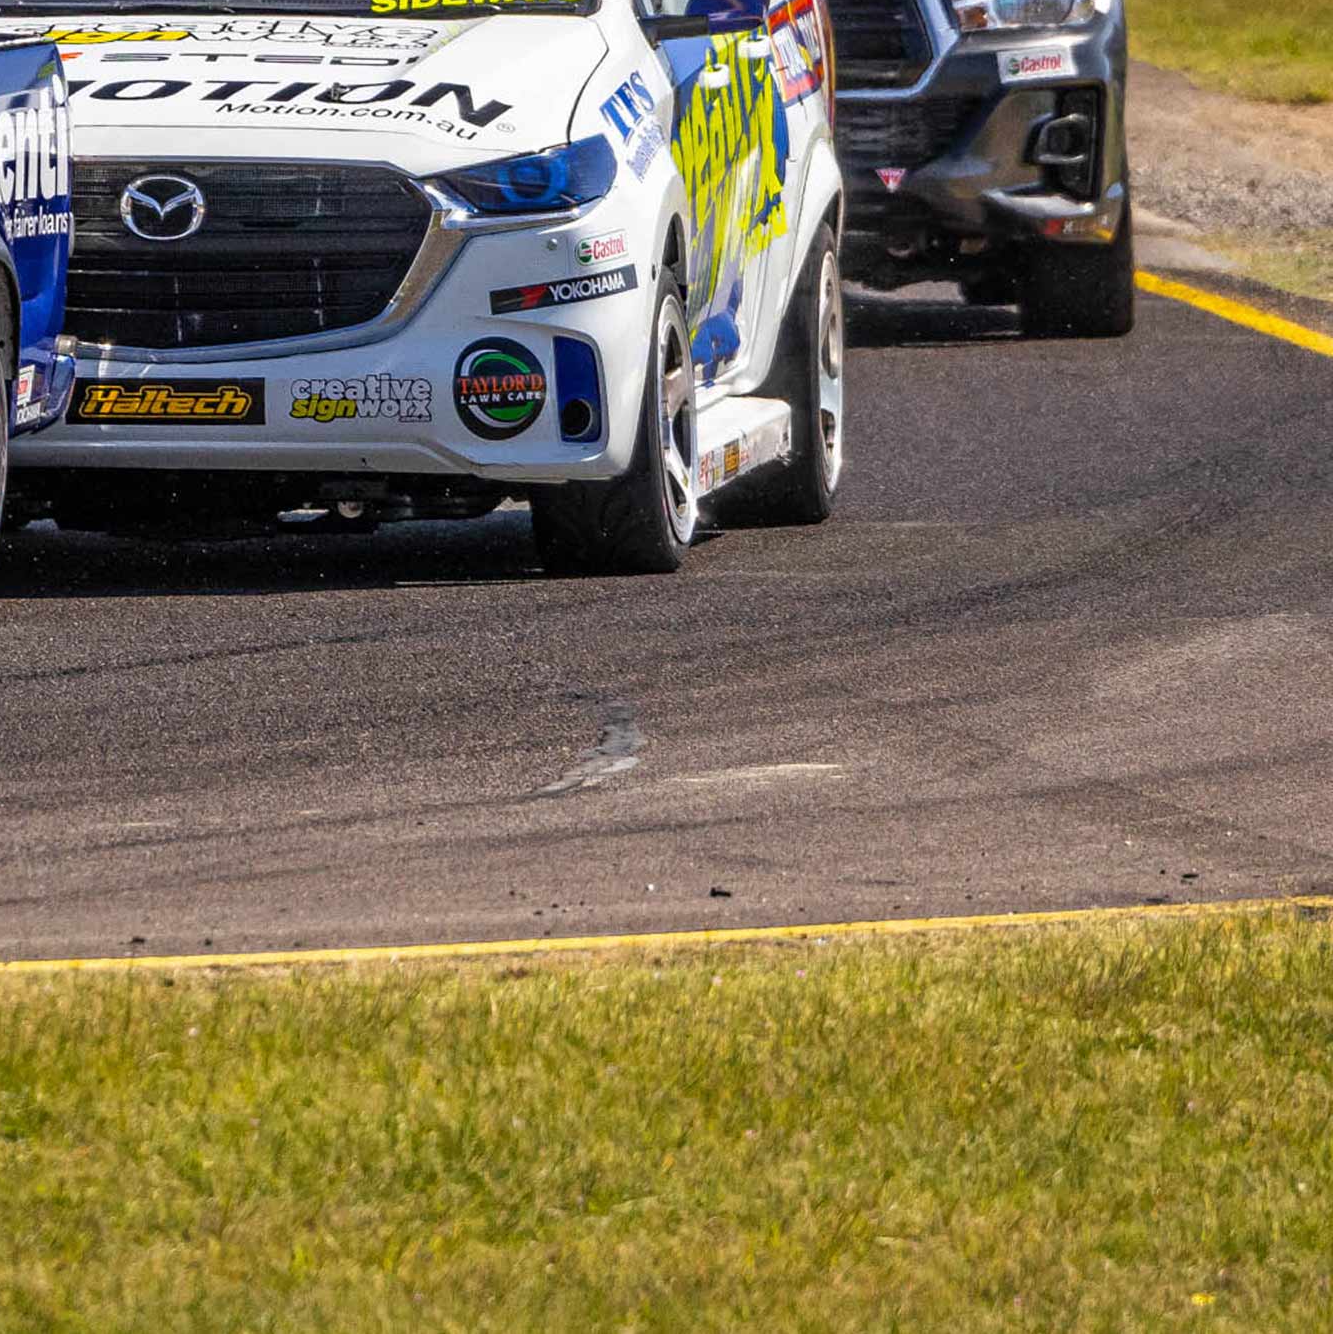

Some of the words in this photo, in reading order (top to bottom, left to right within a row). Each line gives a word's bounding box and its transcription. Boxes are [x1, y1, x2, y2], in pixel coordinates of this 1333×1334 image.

[1020, 53, 1062, 75] Castrol
[67, 79, 512, 128] OTION
[217, 102, 478, 141] Motion.com.au
[593, 236, 626, 261] Castrol
[549, 272, 626, 302] YOKOHAMA
[290, 372, 431, 400] creative
[459, 370, 543, 394] TAYLOR'D
[83, 386, 252, 420] Haltech
[291, 394, 432, 422] signworx
[460, 391, 501, 404] LAWN
[505, 391, 542, 404] CARE
